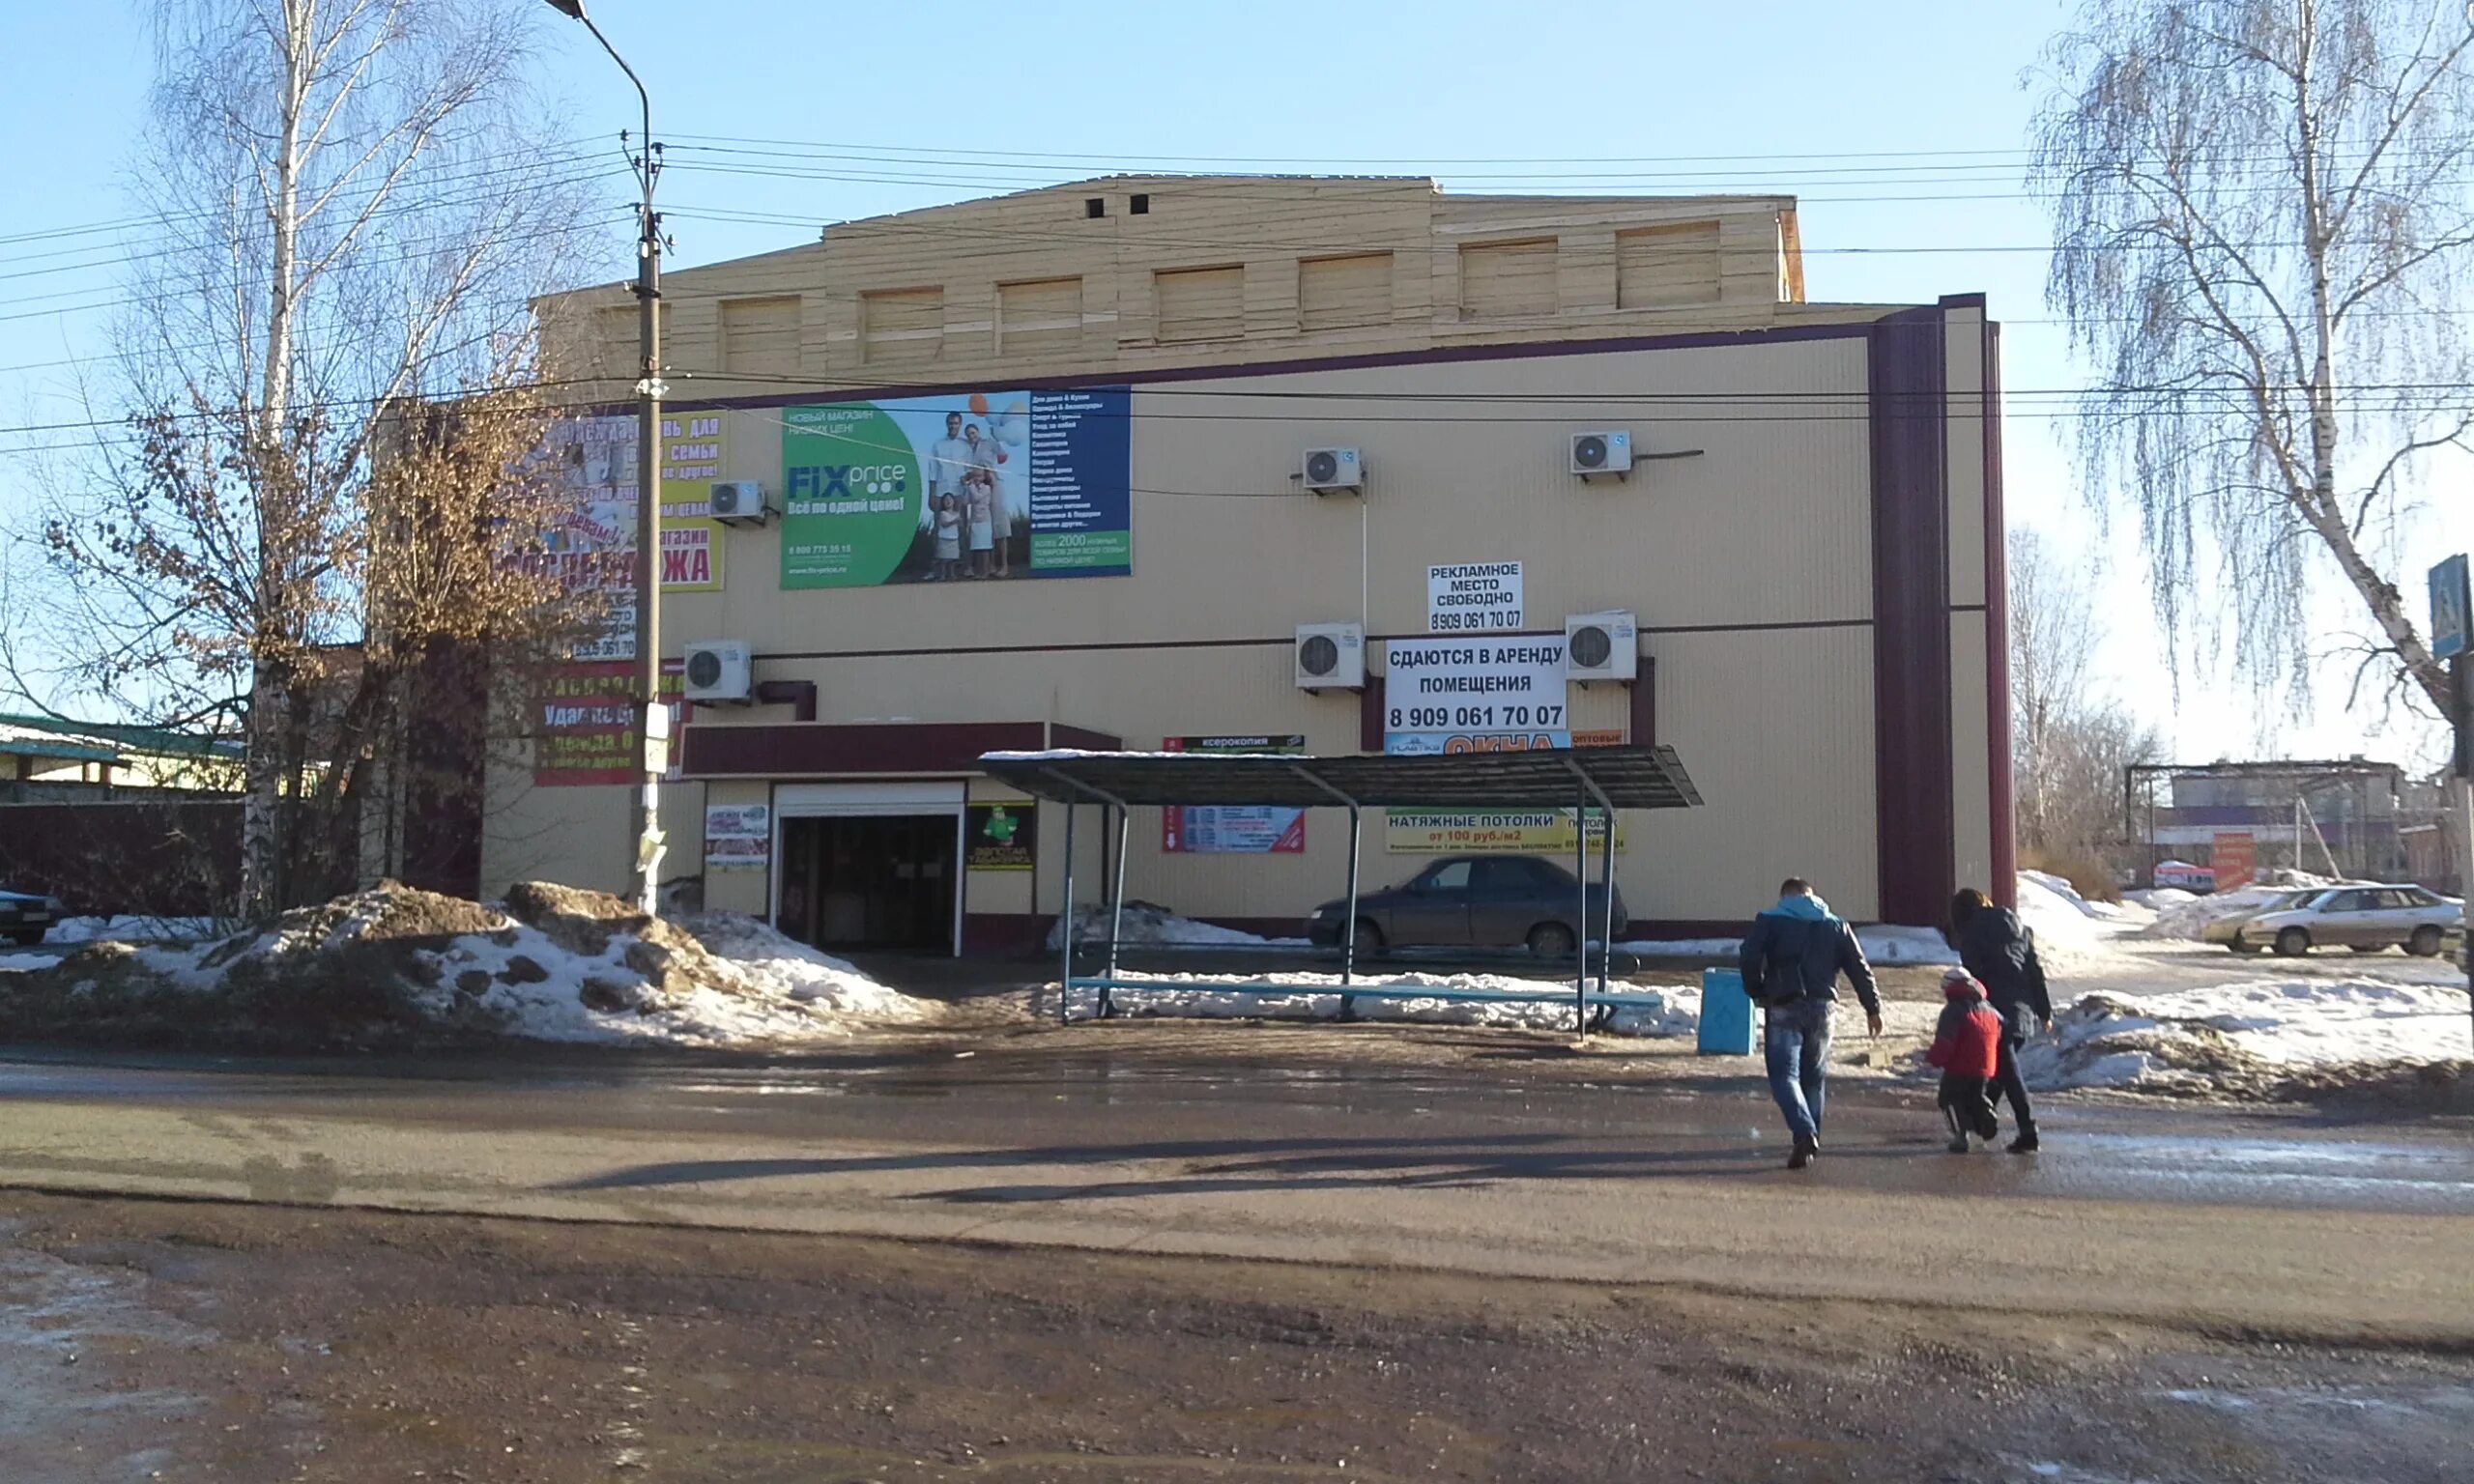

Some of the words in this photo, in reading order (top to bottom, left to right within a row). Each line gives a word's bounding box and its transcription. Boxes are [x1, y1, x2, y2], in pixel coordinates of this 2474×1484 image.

[789, 412, 825, 423] НОВЫЙ
[827, 411, 873, 421] МАГАЗИН
[830, 423, 853, 434] ЦЕН!
[849, 464, 906, 486] price
[788, 500, 811, 515] Всё
[812, 501, 827, 513] по
[829, 498, 868, 515] одной
[870, 497, 905, 513] цене!
[1058, 534, 1086, 548] 2000
[1430, 563, 1519, 579] РЕКЛАМНОЕ
[1451, 580, 1499, 592] МЕСТО
[1437, 591, 1513, 607] СВОБОДНО
[1431, 613, 1439, 630] 8
[1440, 613, 1461, 630] 909
[1464, 612, 1485, 629] 061
[1490, 611, 1504, 628] 70
[1507, 611, 1520, 627] 07
[1390, 648, 1474, 669] СДАЮТСЯ
[1479, 648, 1490, 664] В
[1495, 646, 1563, 666] АРЕНДУ
[1420, 675, 1531, 695] ПОМЕЩЕНИЯ
[1390, 707, 1402, 727] 8
[1409, 707, 1449, 727] 909
[1455, 706, 1493, 726] 061
[1503, 706, 1530, 725] 70
[1536, 706, 1563, 725] 07
[1202, 737, 1269, 748] ксерокопия
[1444, 733, 1555, 755] ОКНА
[1389, 816, 1476, 828] НАТЯЖНЫЕ
[1482, 814, 1554, 827] ПОТОЛКИ
[1429, 832, 1443, 842] от
[1447, 831, 1470, 841] 100
[1474, 830, 1522, 842] руб./м2
